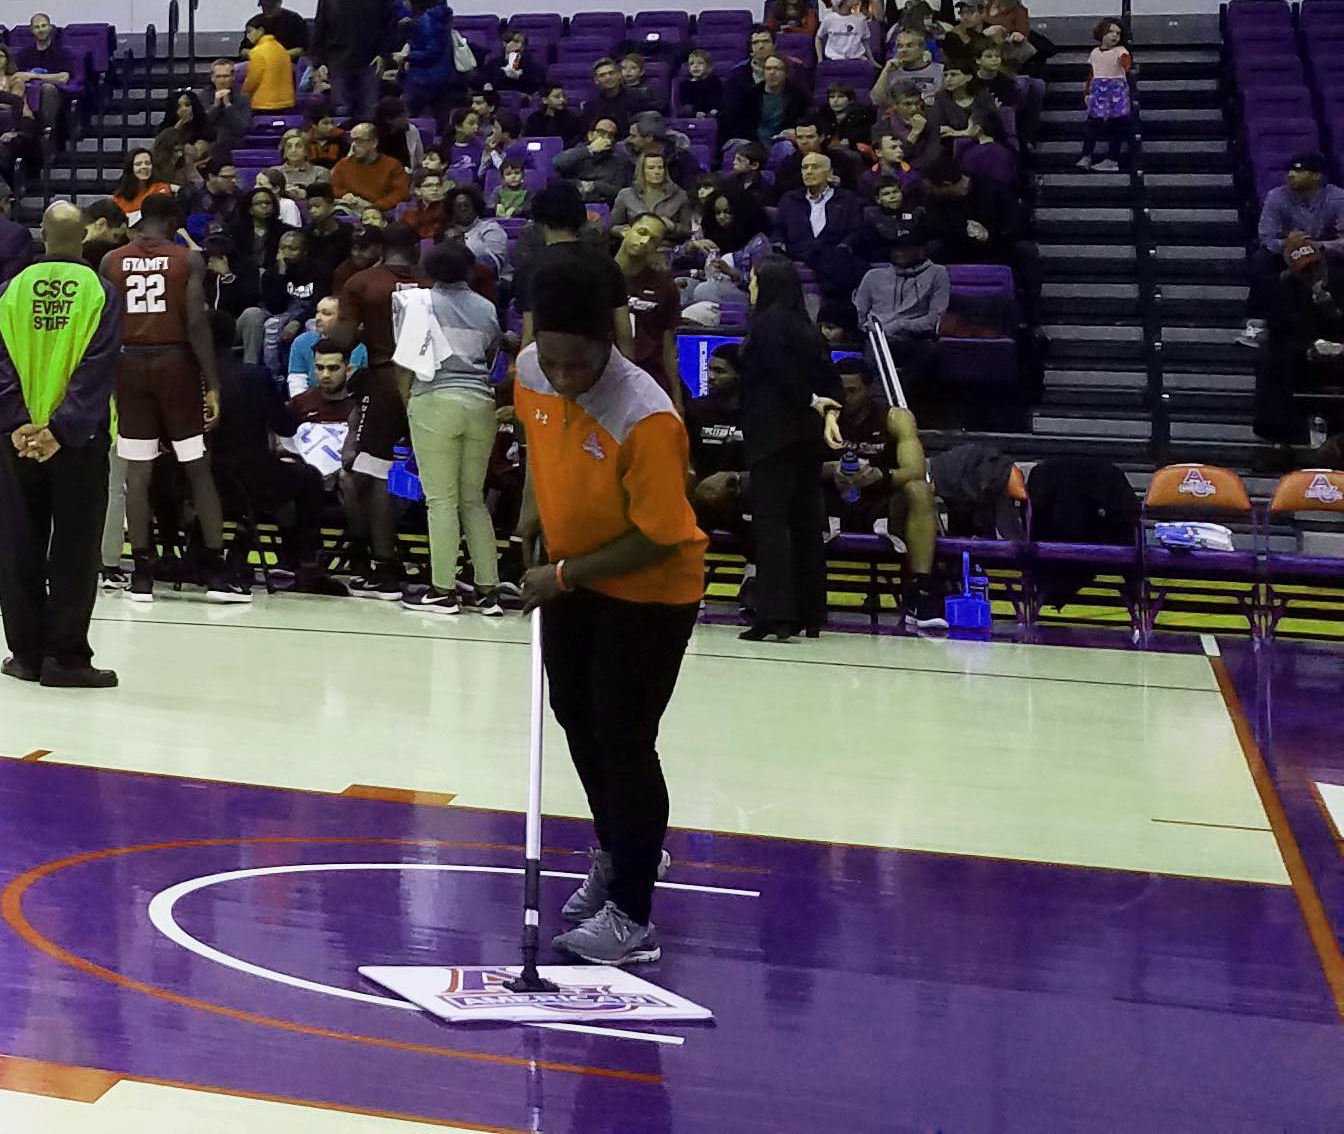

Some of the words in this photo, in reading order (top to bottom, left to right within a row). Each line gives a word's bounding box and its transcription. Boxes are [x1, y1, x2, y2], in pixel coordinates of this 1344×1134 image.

[32, 279, 79, 298] CSC
[125, 274, 167, 313] 22
[32, 300, 73, 316] EVENT
